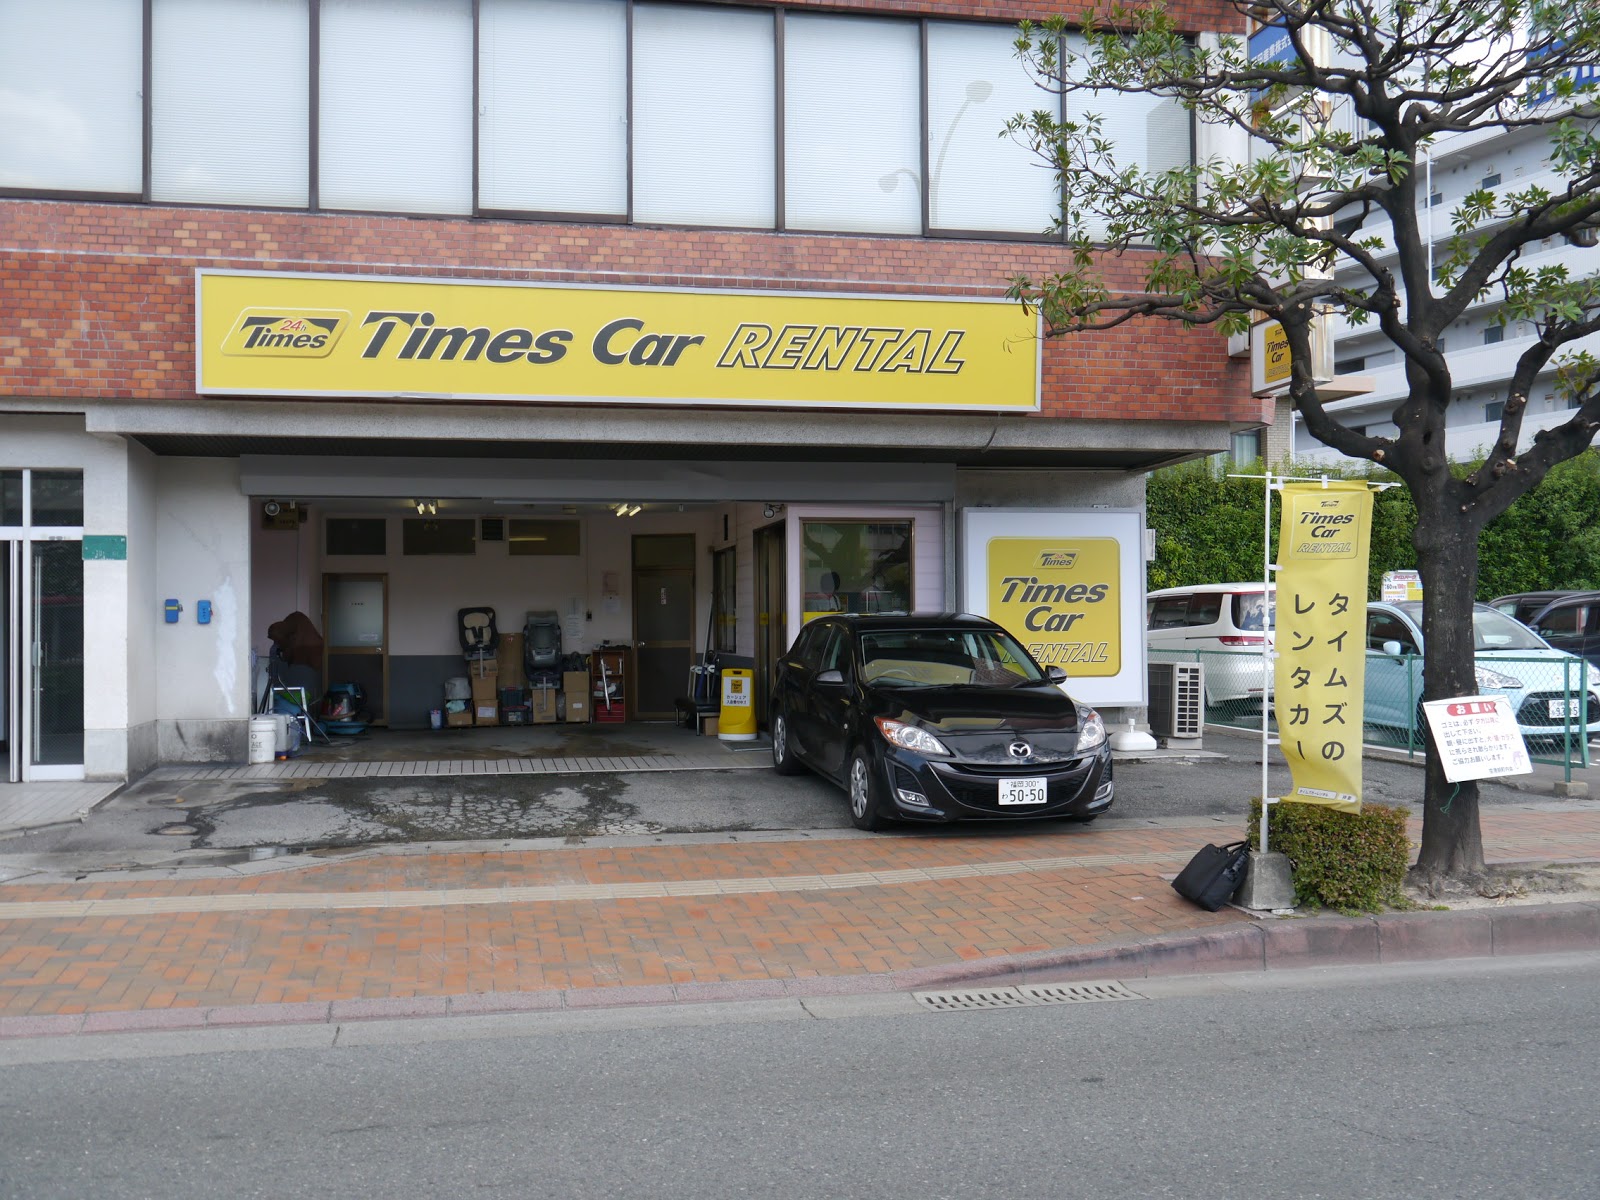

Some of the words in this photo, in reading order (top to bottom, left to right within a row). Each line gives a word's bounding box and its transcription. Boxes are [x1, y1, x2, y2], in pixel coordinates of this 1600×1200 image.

[240, 316, 340, 349] Times
[360, 311, 574, 365] Times
[592, 317, 706, 368] Car
[715, 322, 967, 375] RENTAL
[1266, 340, 1289, 353] Times
[1271, 351, 1285, 363] Car
[1300, 511, 1355, 525] Times
[1311, 525, 1341, 538] Car
[1297, 542, 1352, 554] RENTAL
[1039, 552, 1077, 566] Times
[1000, 576, 1109, 604] Times
[1024, 605, 1085, 632] Car
[1289, 593, 1315, 761] レンタカー
[1321, 592, 1349, 762] タイムズの
[1009, 788, 1045, 802] 50-50
